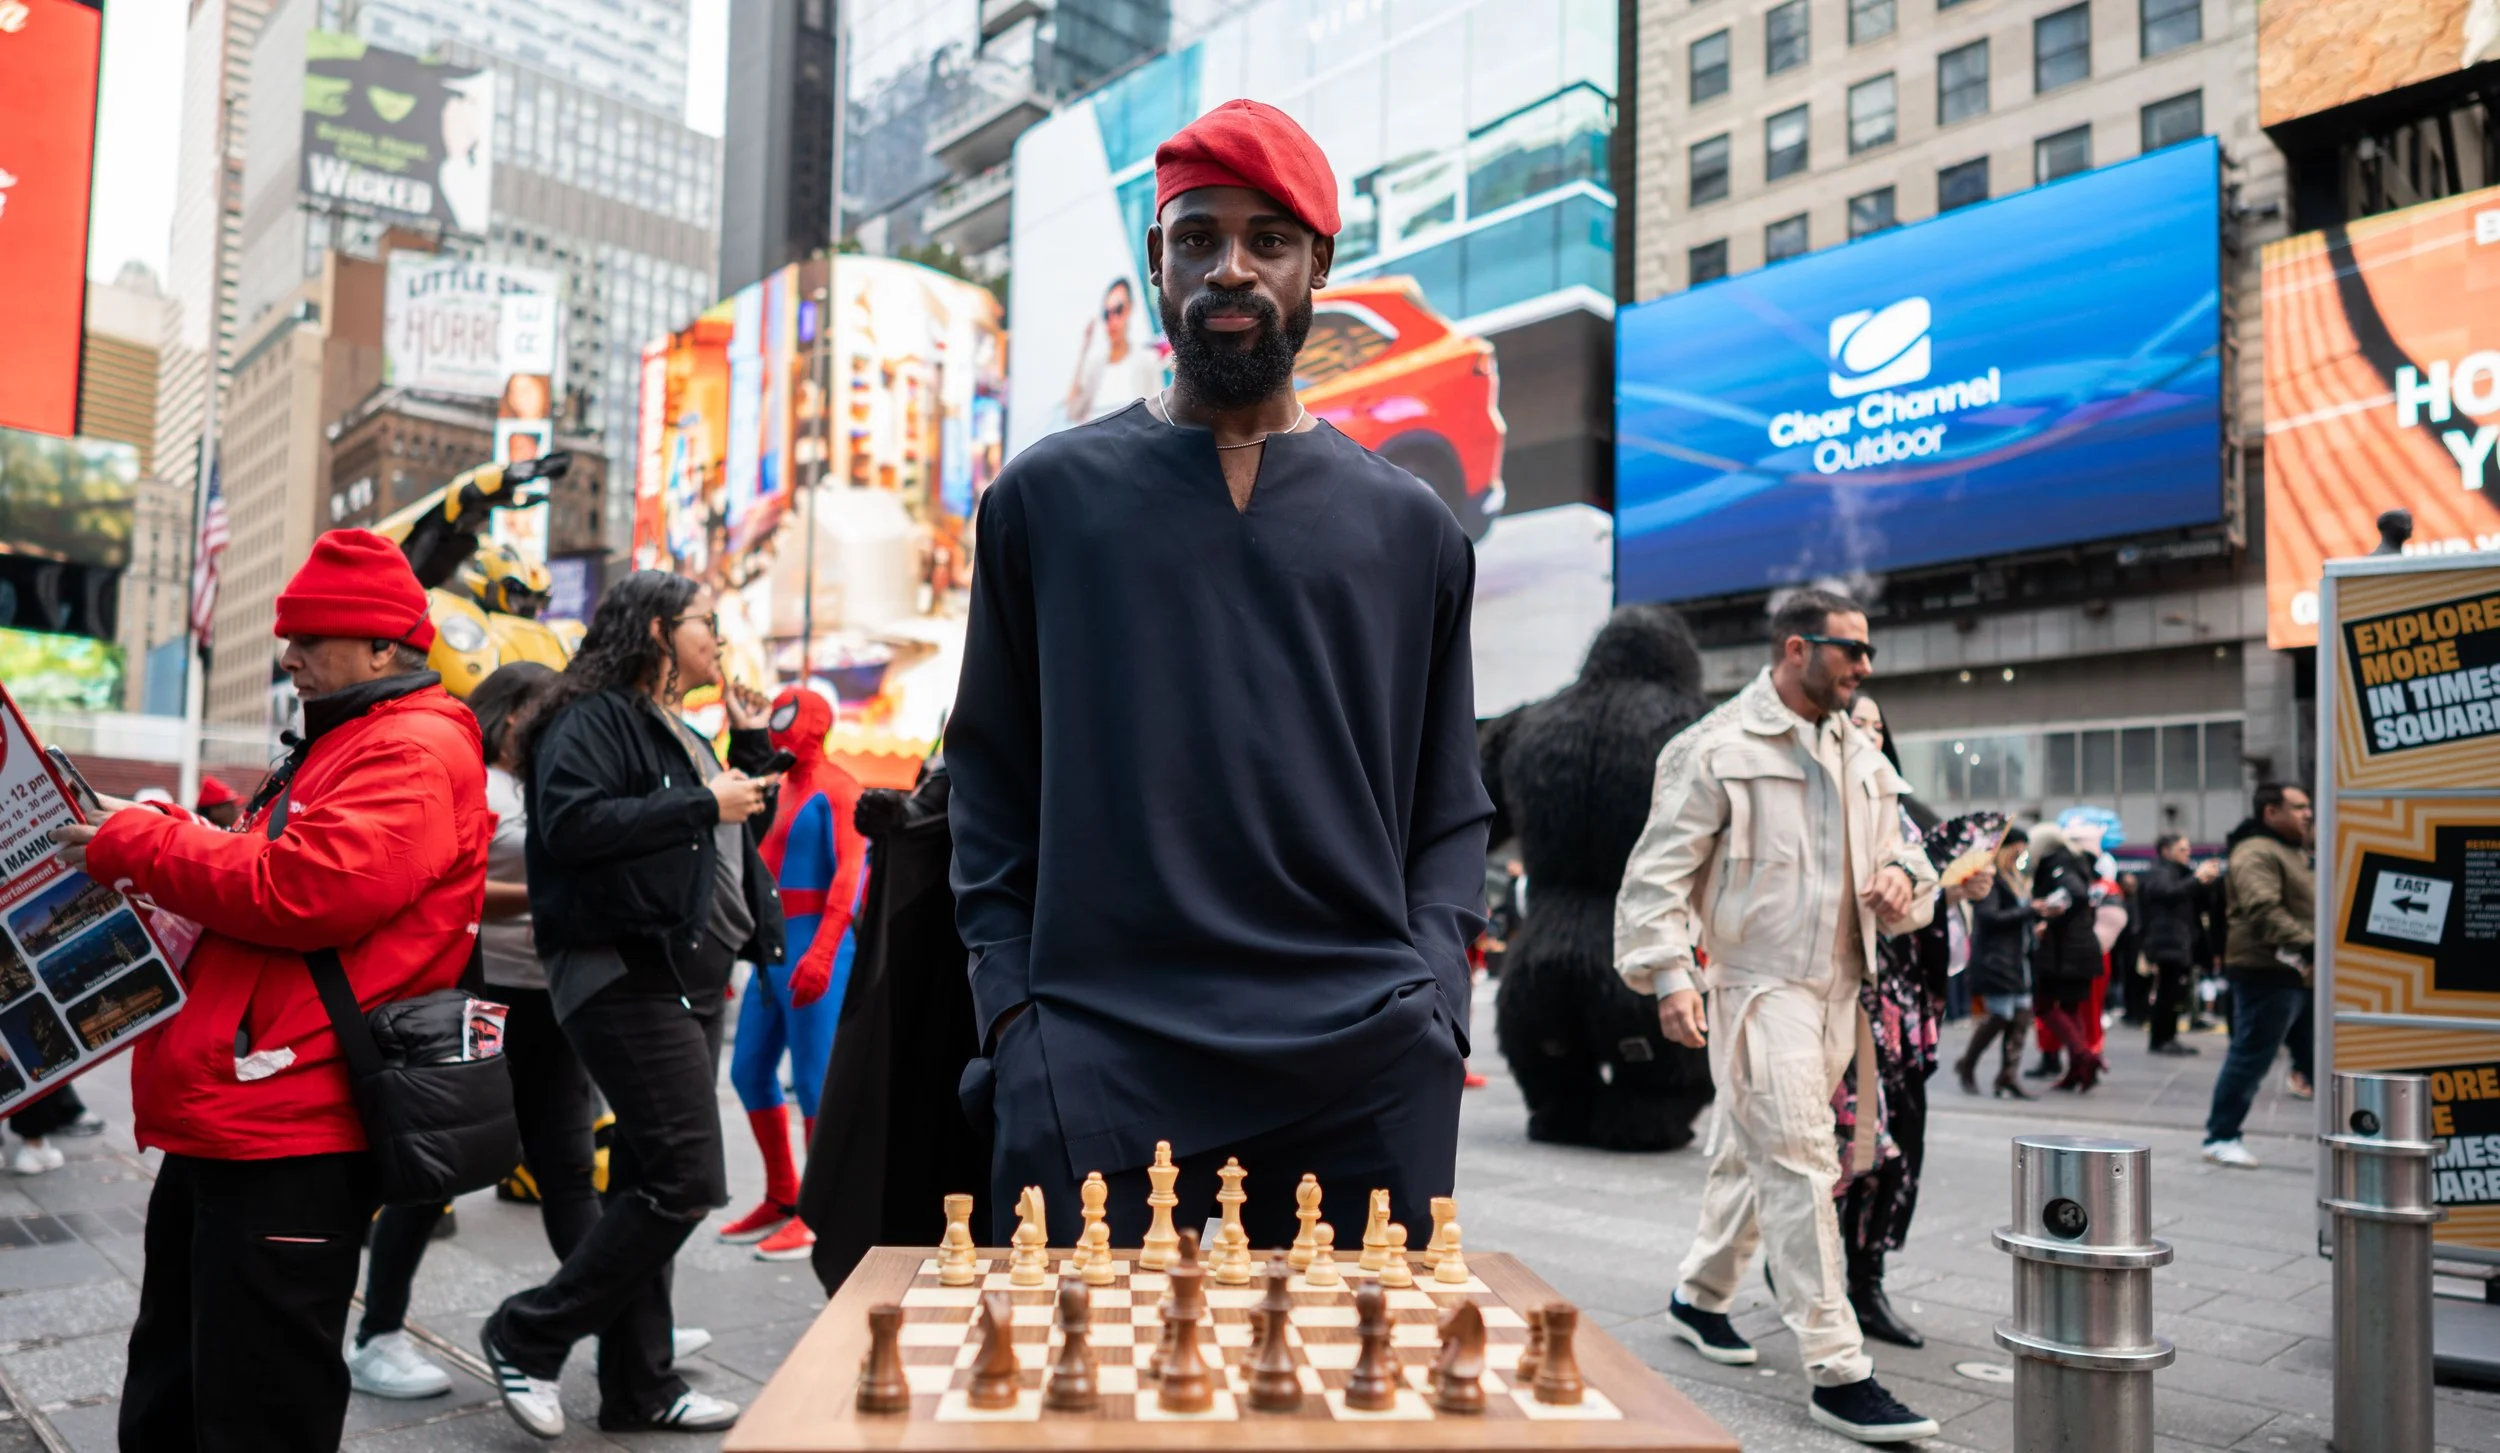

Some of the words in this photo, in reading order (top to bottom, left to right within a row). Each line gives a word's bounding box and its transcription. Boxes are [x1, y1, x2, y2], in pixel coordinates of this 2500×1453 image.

[1768, 406, 1856, 448] Clear
[1857, 366, 2001, 429] Channel
[1813, 423, 1948, 475] Outdoor
[2353, 596, 2500, 654] EXPLORE
[2360, 639, 2461, 687] MORE
[2366, 683, 2408, 719] IN
[10, 783, 29, 801] 12
[28, 773, 49, 795] pm
[28, 798, 40, 812] 30
[41, 789, 58, 804] min
[37, 801, 66, 823] hours
[2394, 877, 2431, 896] EAST
